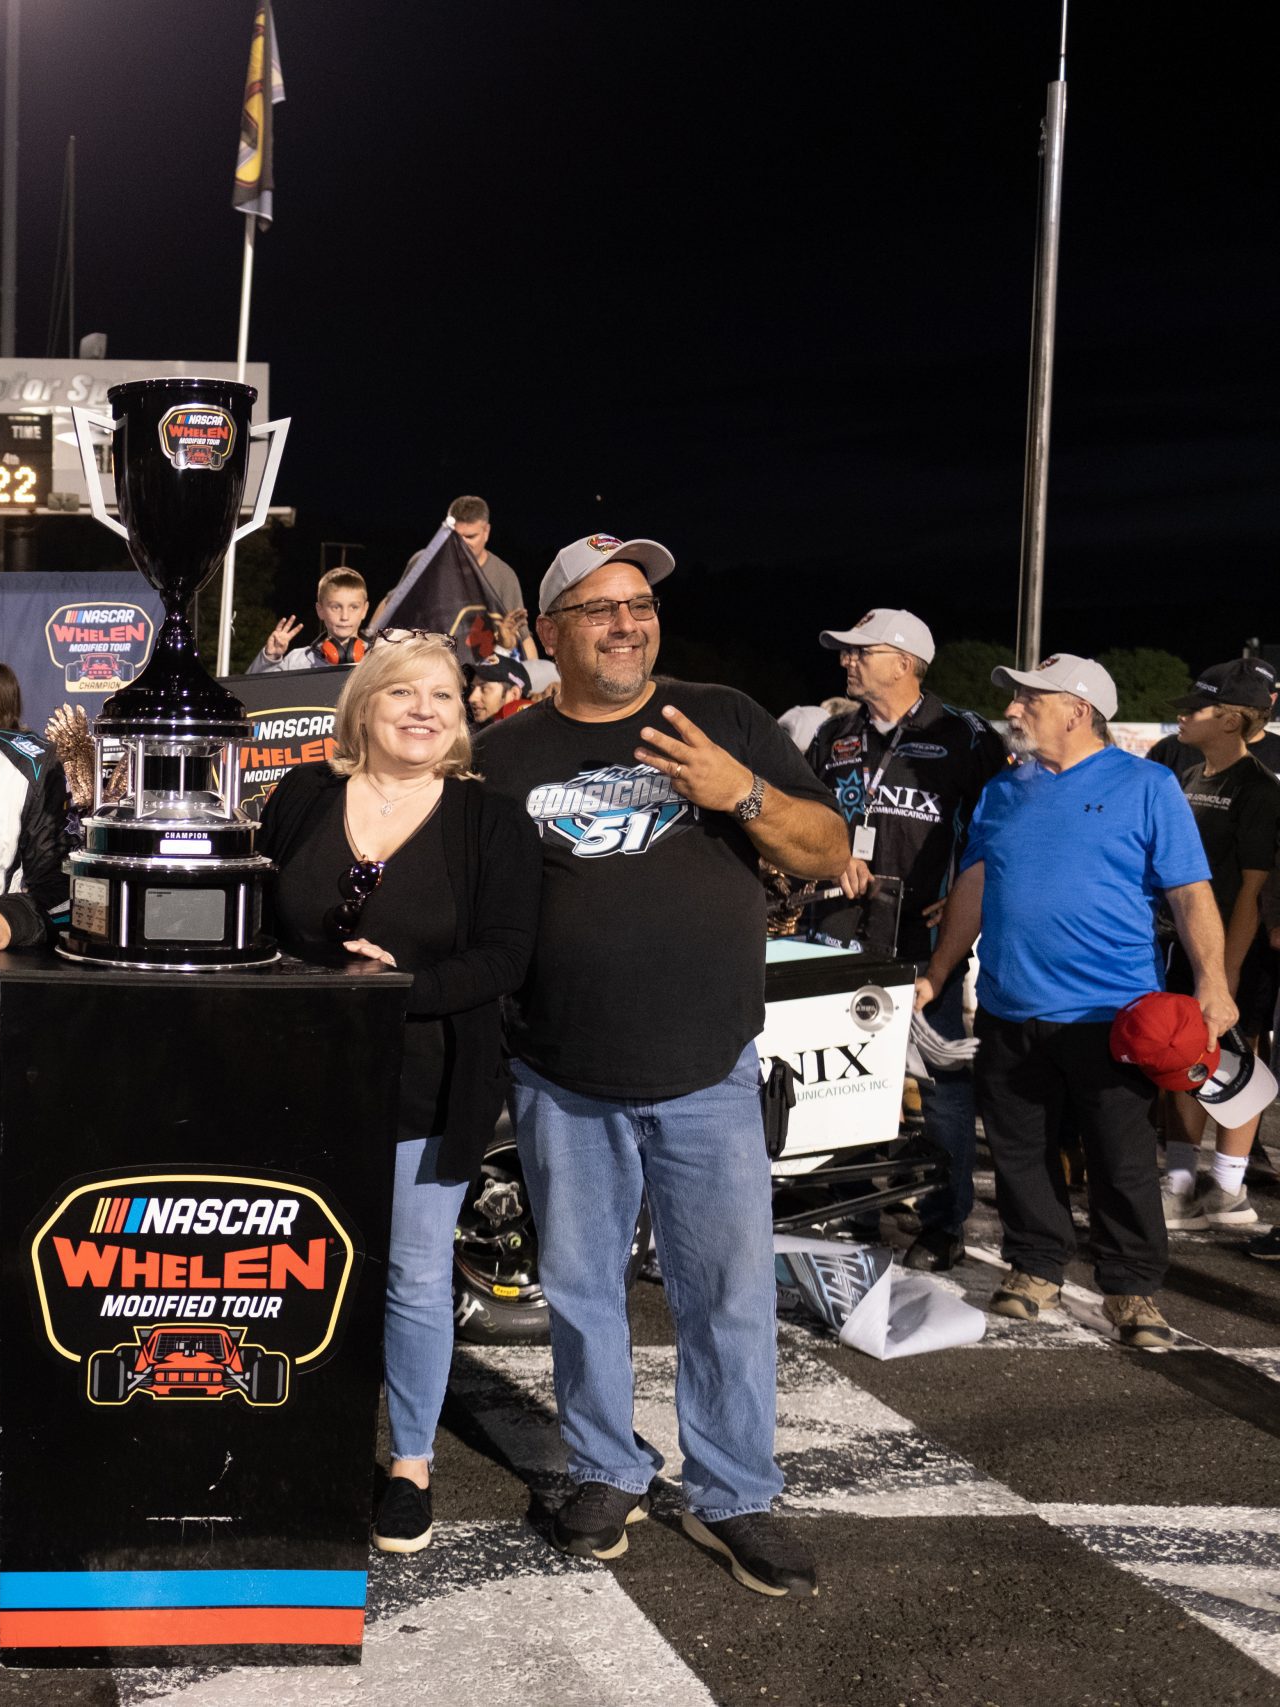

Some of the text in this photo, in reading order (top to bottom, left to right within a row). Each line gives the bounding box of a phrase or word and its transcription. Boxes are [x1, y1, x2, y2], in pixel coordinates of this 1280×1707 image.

[188, 415, 224, 426] NASCAR
[11, 425, 42, 440] TIME
[169, 424, 229, 440] WHELEN
[179, 437, 207, 445] MODIFIED
[2, 452, 21, 465] 4th
[81, 609, 135, 624] NASCAR
[53, 622, 145, 642] WHELEN
[69, 643, 131, 652] MODIFIED TOUR
[79, 681, 121, 690] CHAMPION
[257, 714, 336, 741] NASCAR
[527, 775, 688, 819] BONSIGNO
[164, 831, 209, 840] CHAMPION
[572, 810, 660, 858] 51
[796, 1081, 866, 1102] UNICATIONS
[139, 1197, 300, 1236] NASCAR
[52, 1236, 327, 1290] WHELEN
[99, 1294, 283, 1319] MODIFIED TOUR
